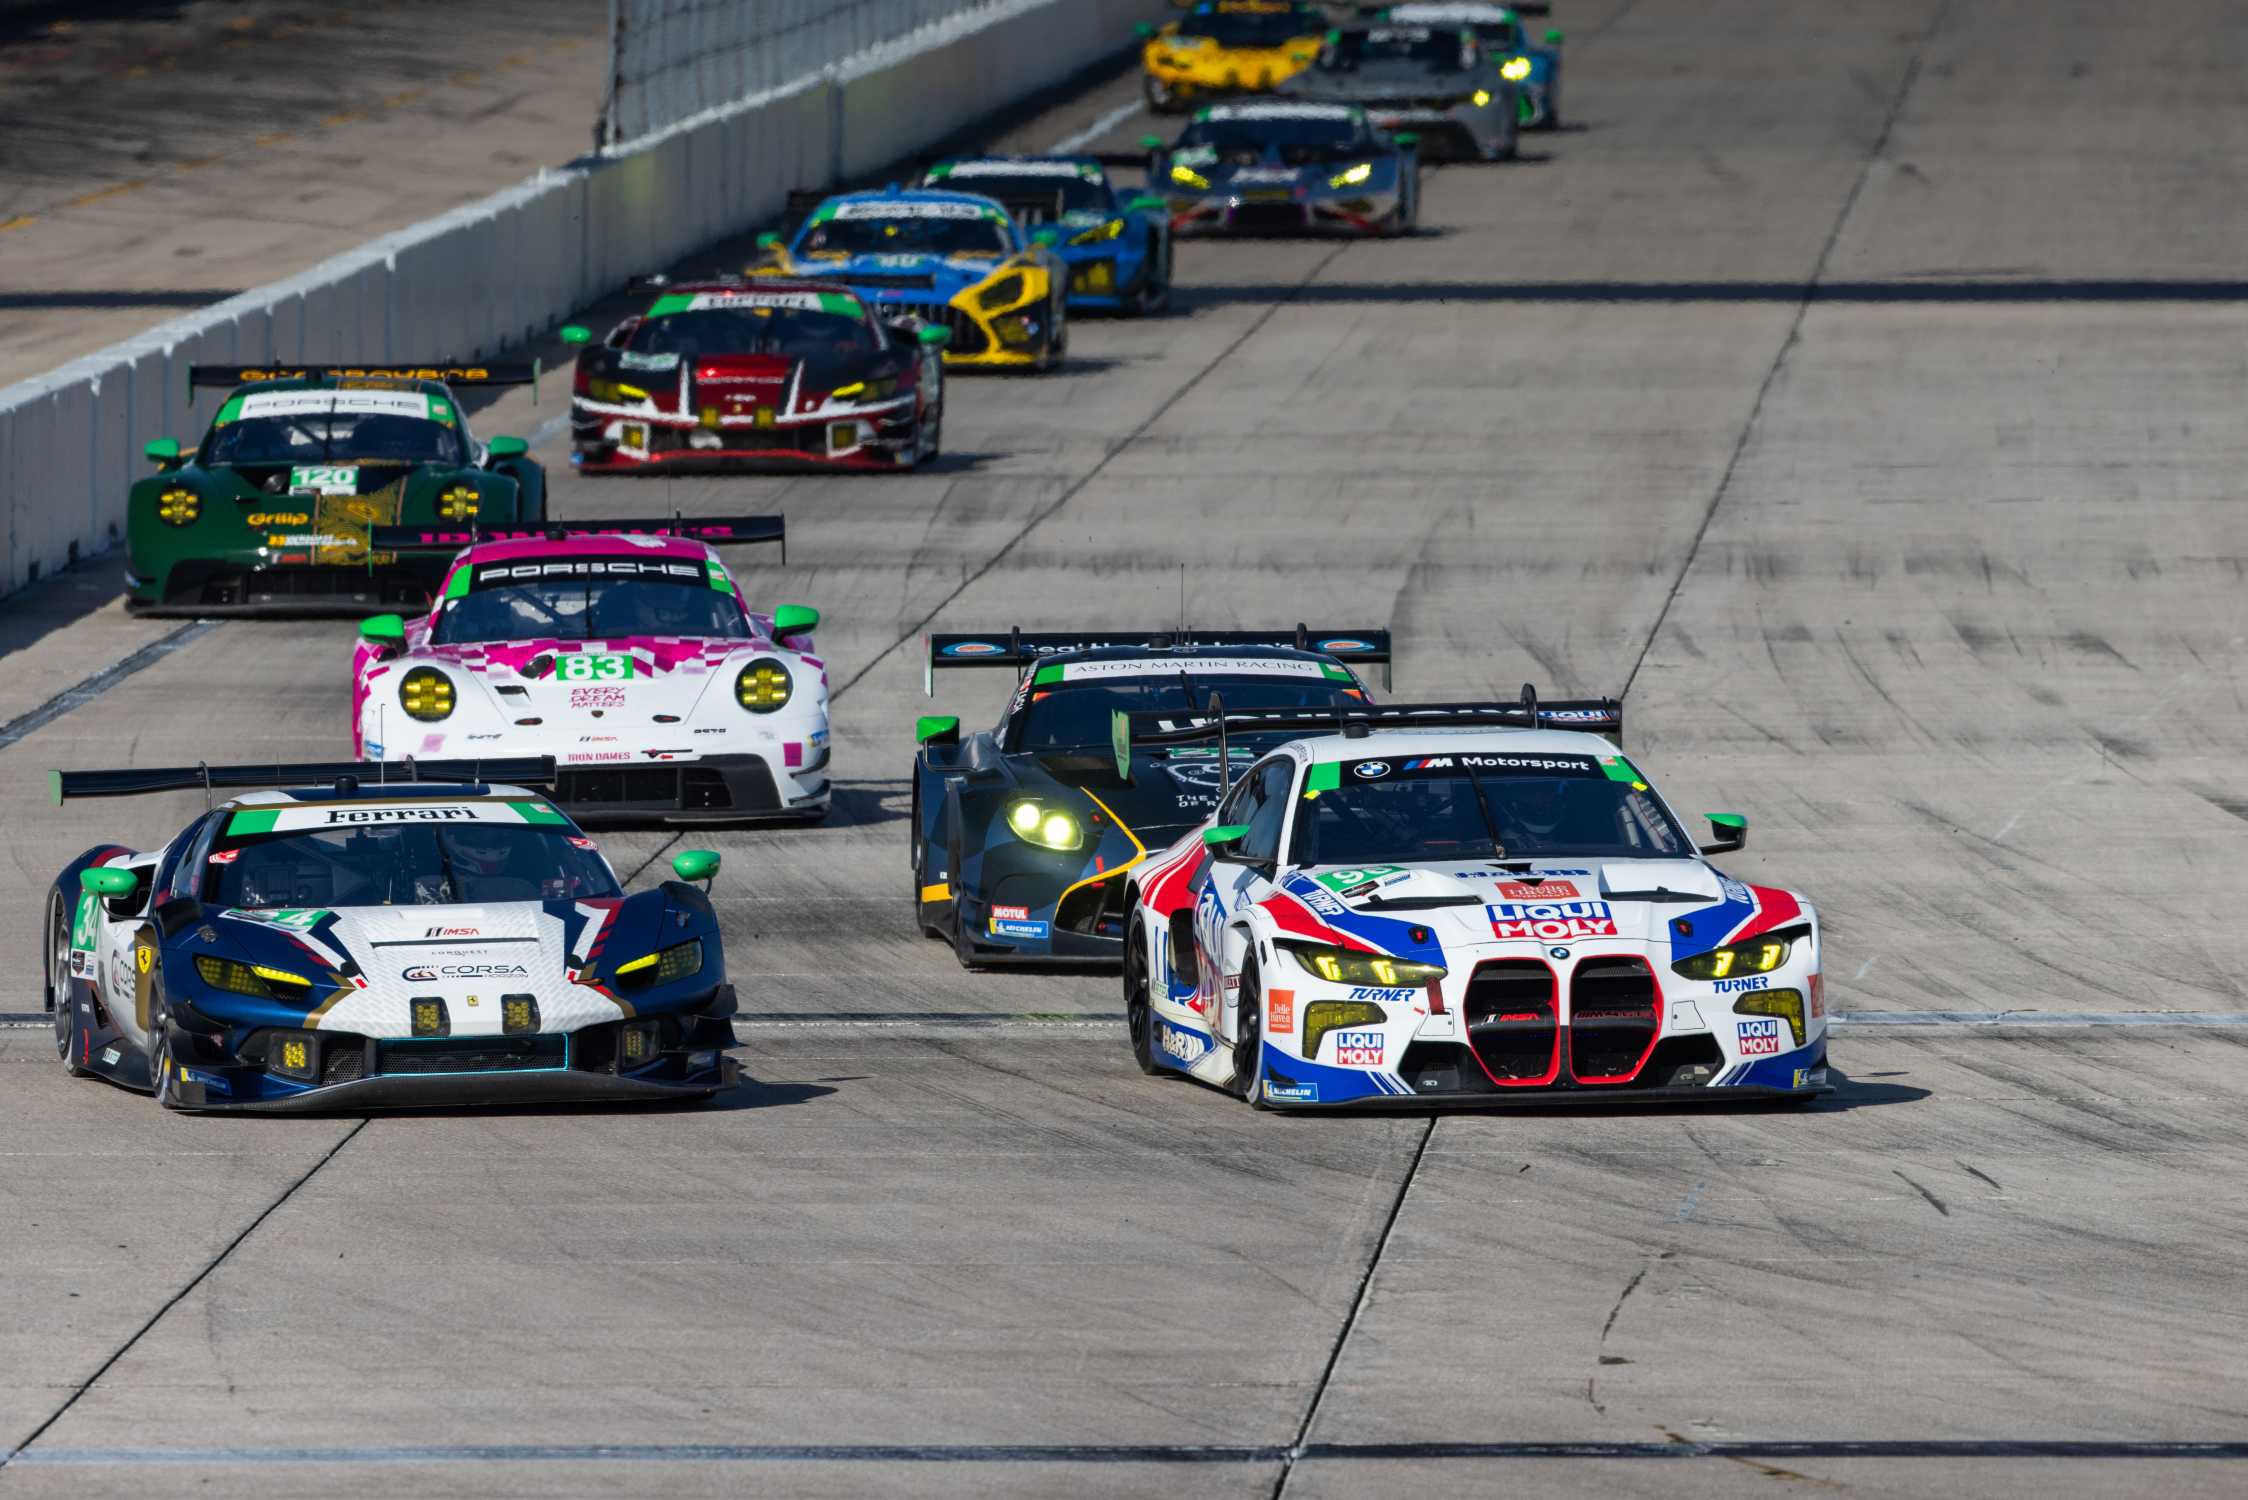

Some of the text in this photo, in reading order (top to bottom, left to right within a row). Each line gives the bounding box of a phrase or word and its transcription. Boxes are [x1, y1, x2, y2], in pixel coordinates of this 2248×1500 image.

[295, 468, 353, 485] 120
[479, 562, 700, 582] PORSCHE
[565, 656, 625, 680] 83
[1074, 661, 1313, 673] ASTON MARTIN RACING
[571, 687, 625, 695] EVERY
[567, 752, 631, 762] IRON DAMES
[1462, 757, 1590, 770] Motorsport
[323, 806, 481, 825] Ferrari
[993, 907, 1027, 919] MOTUL
[1491, 902, 1606, 921] LIQUI
[442, 928, 481, 936] IMSA
[1497, 919, 1613, 939] MOLY
[441, 965, 529, 974] CORSA
[1712, 976, 1769, 994] TURNER
[1348, 987, 1416, 1002] TURNER
[1739, 1021, 1777, 1037] LIQUI
[1339, 1034, 1383, 1049] LIQUI
[1741, 1036, 1778, 1053] MOLY
[1339, 1049, 1383, 1065] MOLY
